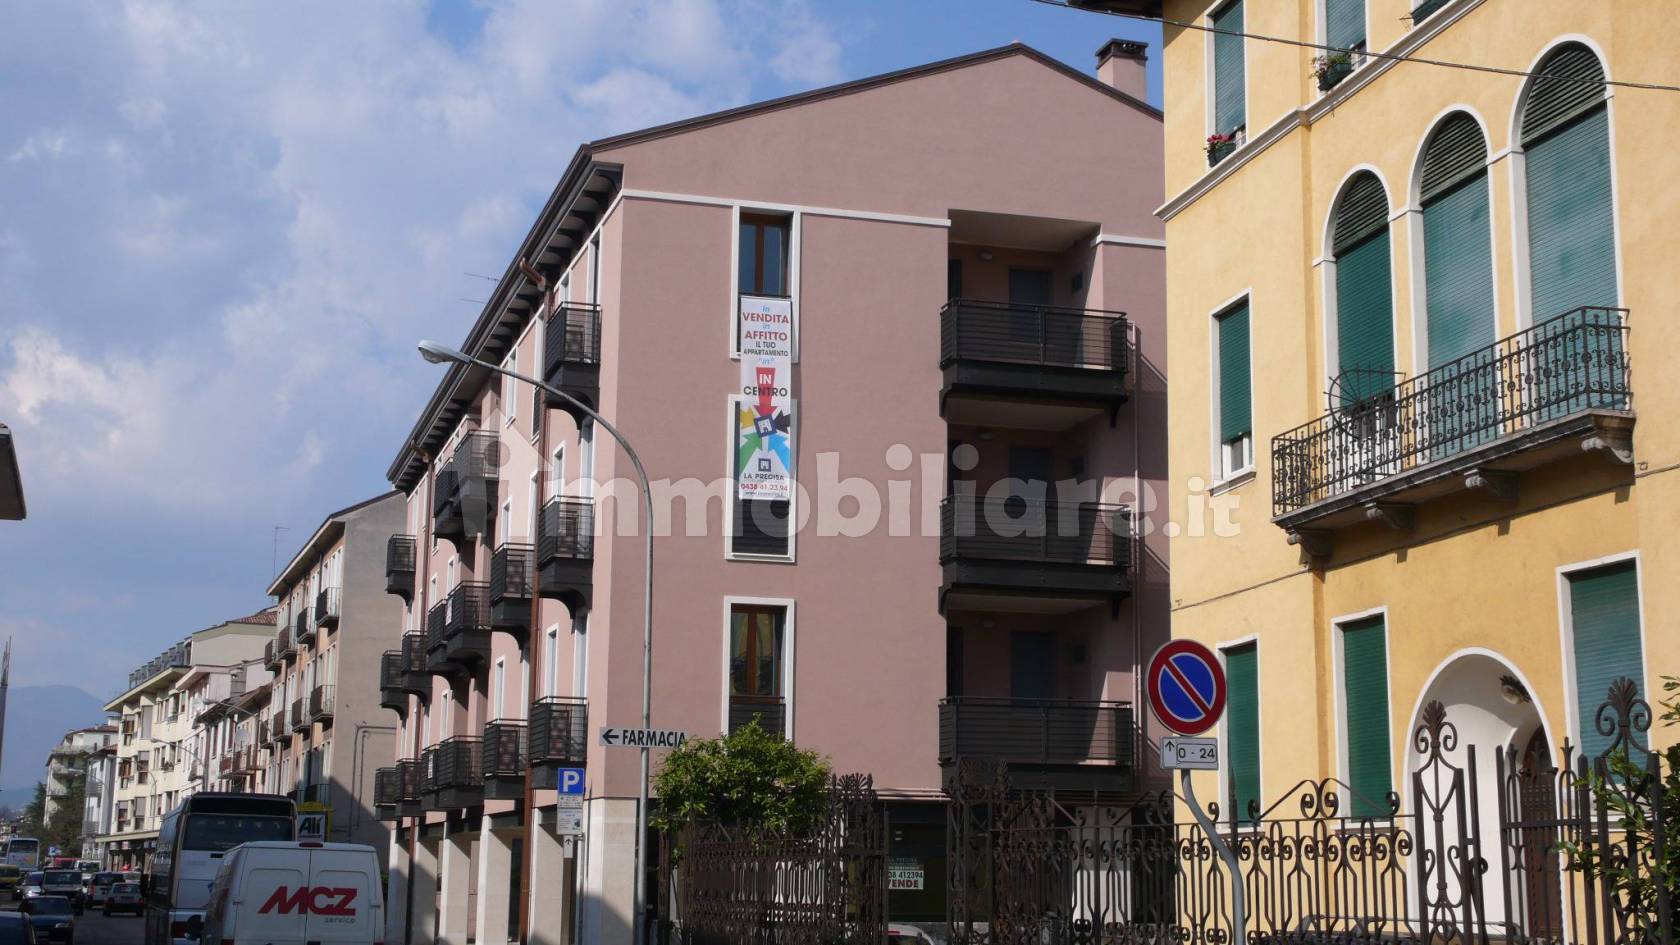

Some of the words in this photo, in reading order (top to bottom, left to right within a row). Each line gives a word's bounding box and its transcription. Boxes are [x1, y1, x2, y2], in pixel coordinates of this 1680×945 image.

[742, 312, 789, 324] VENDITA
[744, 330, 788, 341] AFFITTO
[763, 341, 776, 349] TUO
[743, 348, 789, 357] APPARTAMENTO
[759, 373, 772, 385] IN
[743, 386, 788, 397] CENTRO
[622, 729, 687, 747] FARMACIA
[1199, 748, 1215, 759] 24
[563, 770, 580, 793] P
[257, 886, 358, 916] MCZ
